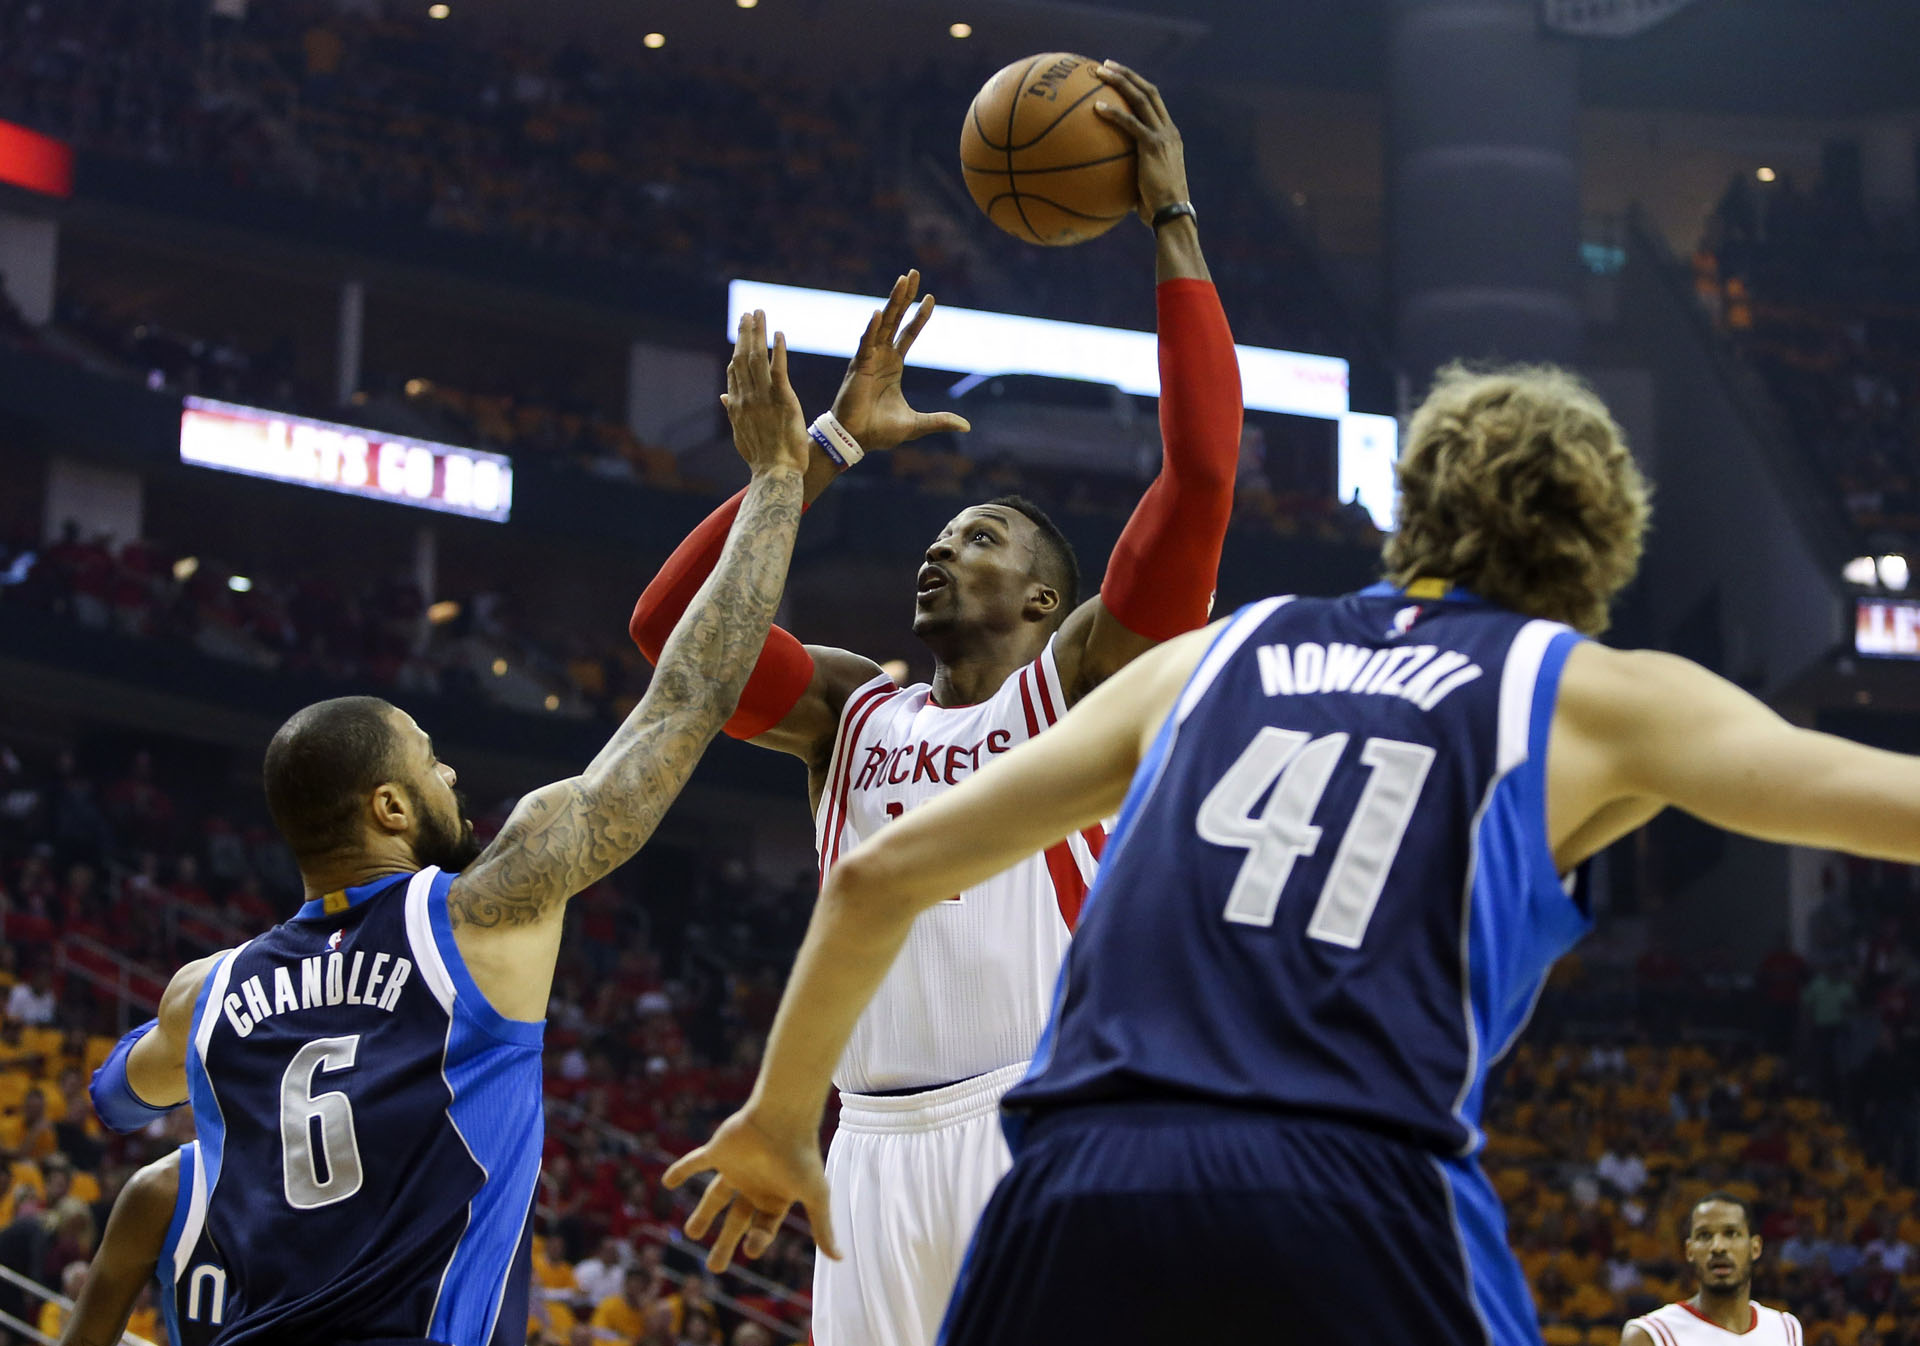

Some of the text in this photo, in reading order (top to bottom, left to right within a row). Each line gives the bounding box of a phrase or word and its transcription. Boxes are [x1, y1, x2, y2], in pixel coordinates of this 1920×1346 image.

[1256, 641, 1483, 712] NOWITZKI
[853, 729, 1012, 791] ROCKETS
[1195, 725, 1437, 949] 41
[223, 950, 412, 1038] CHANDLER
[280, 1034, 363, 1209] 6
